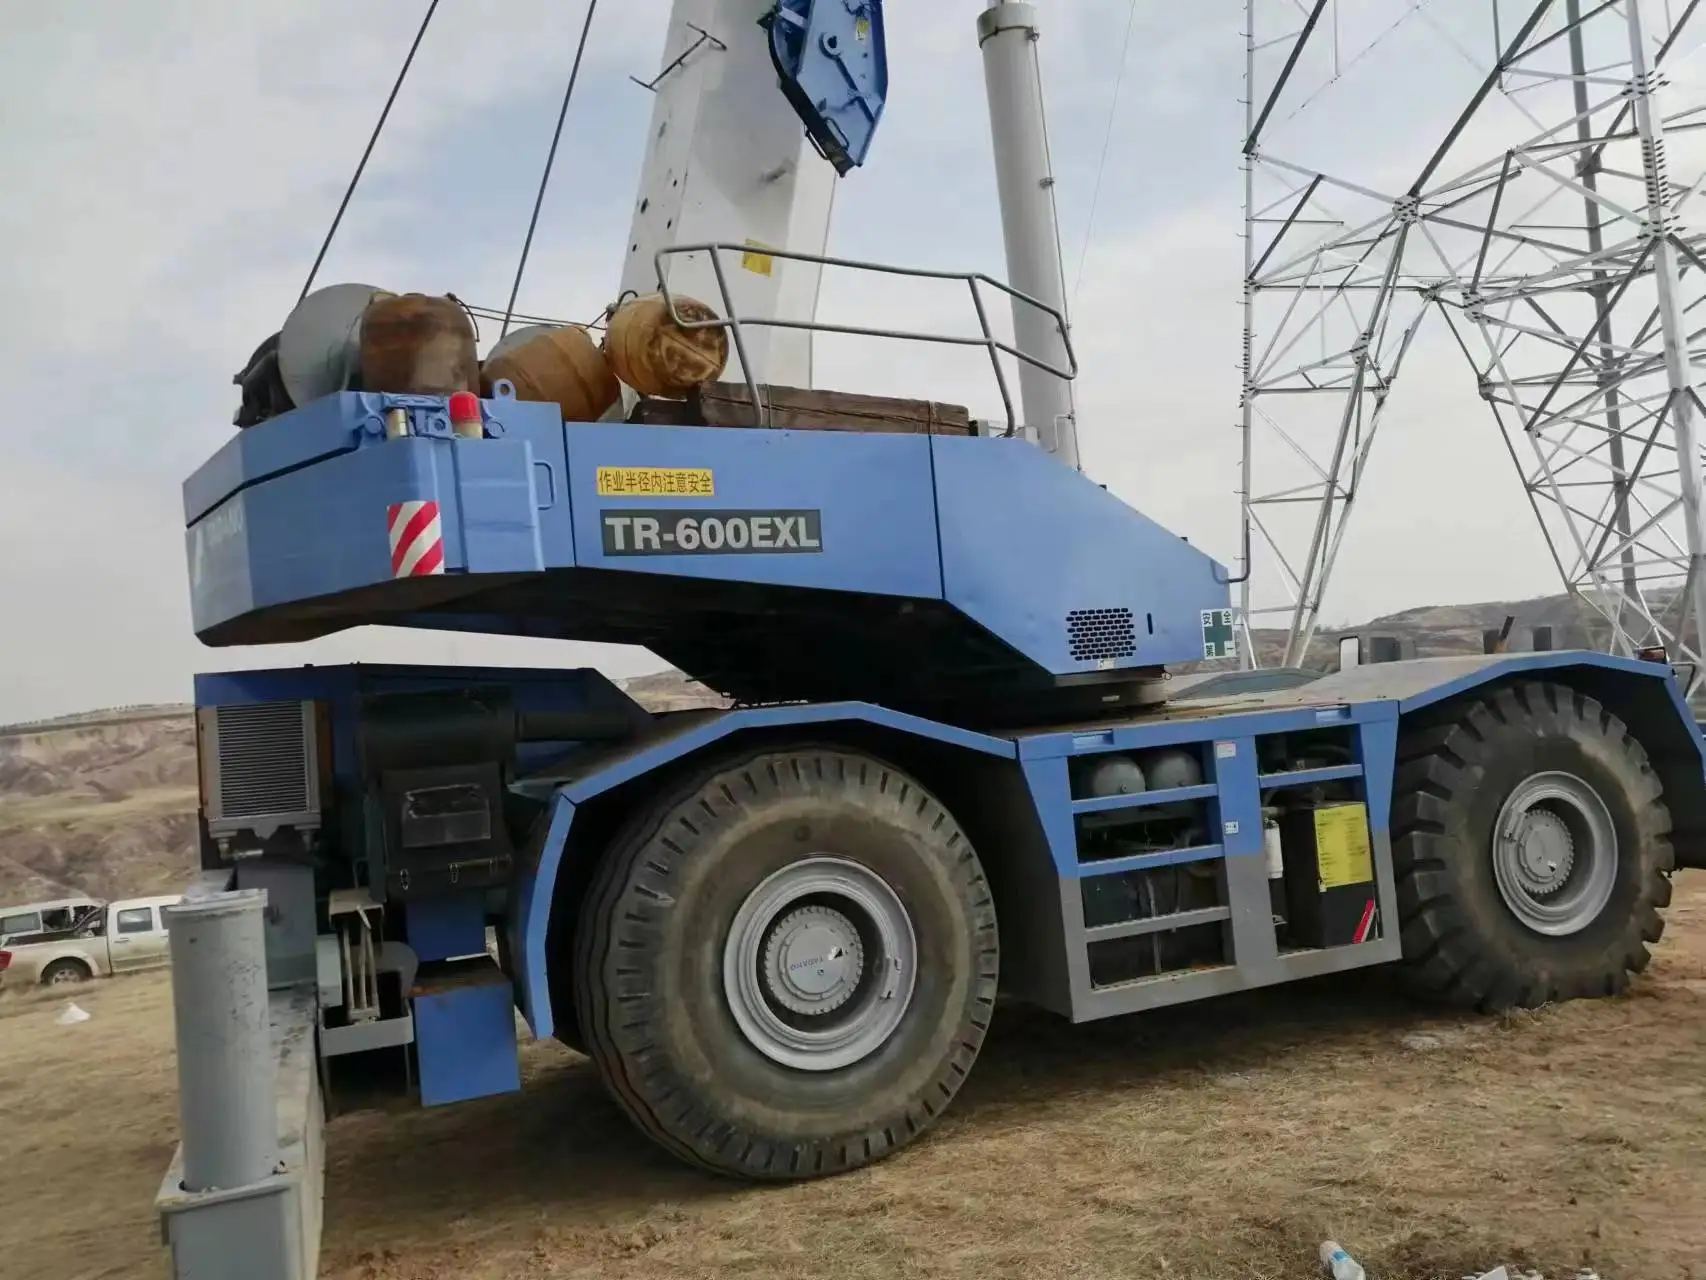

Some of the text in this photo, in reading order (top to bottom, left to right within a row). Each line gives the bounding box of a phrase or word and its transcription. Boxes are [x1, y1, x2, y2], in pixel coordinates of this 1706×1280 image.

[599, 469, 712, 493] 作业半径内注意安全
[604, 516, 820, 550] TR-600EXL
